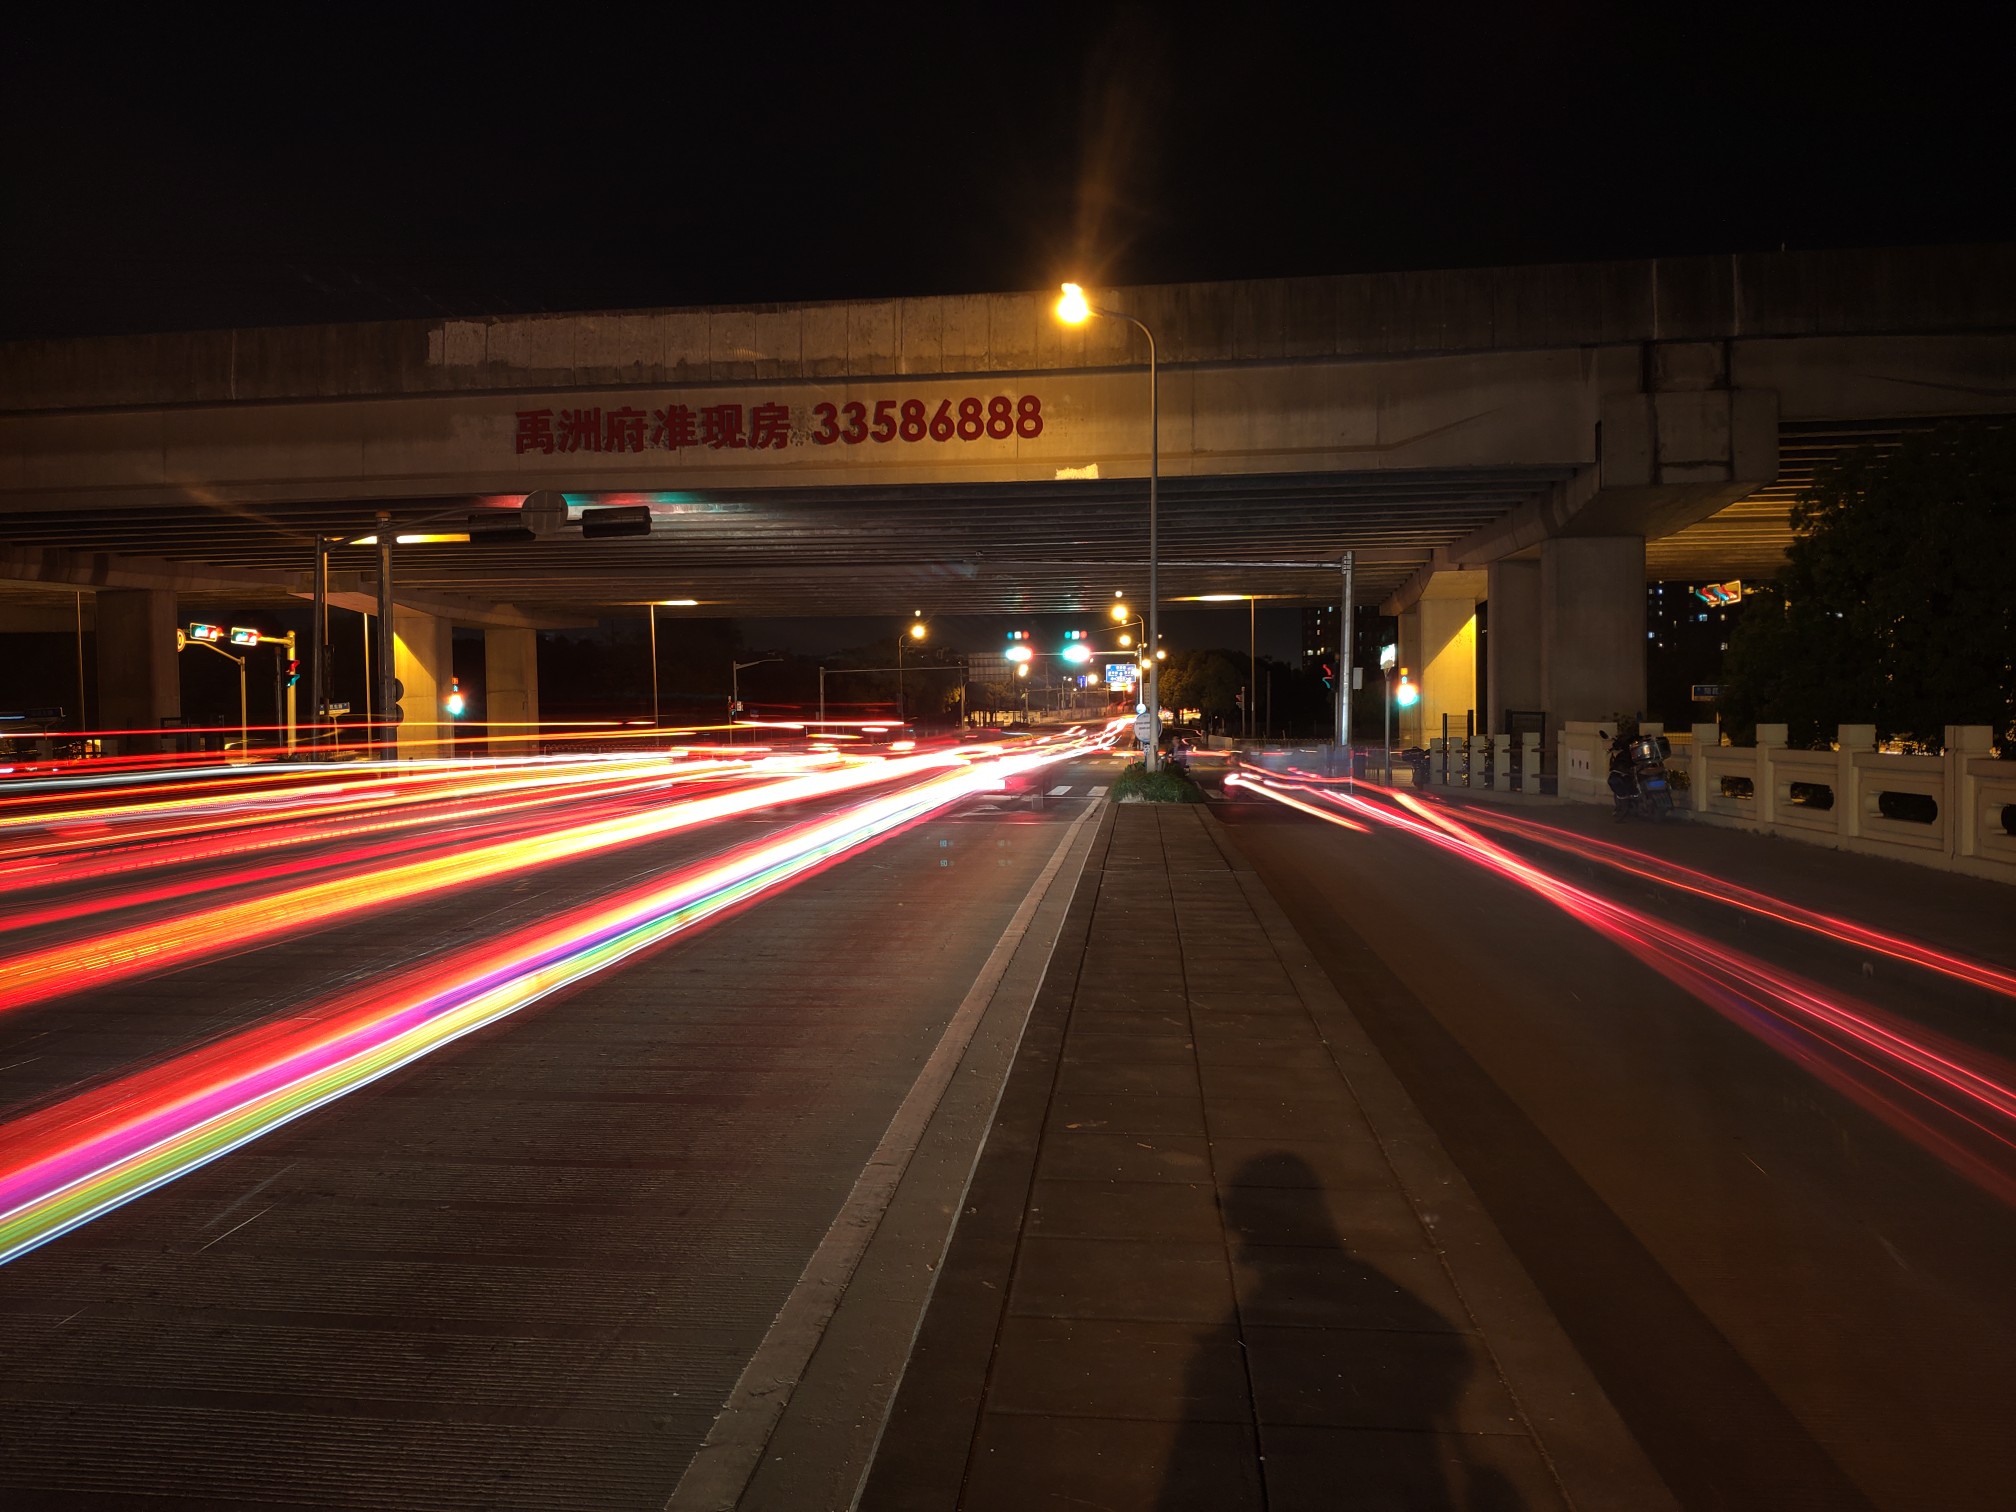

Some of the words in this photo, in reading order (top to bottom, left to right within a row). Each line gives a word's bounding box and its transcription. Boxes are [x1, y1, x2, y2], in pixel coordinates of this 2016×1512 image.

[515, 403, 791, 455] 禹洲府准现房
[813, 395, 1043, 445] 33586888
